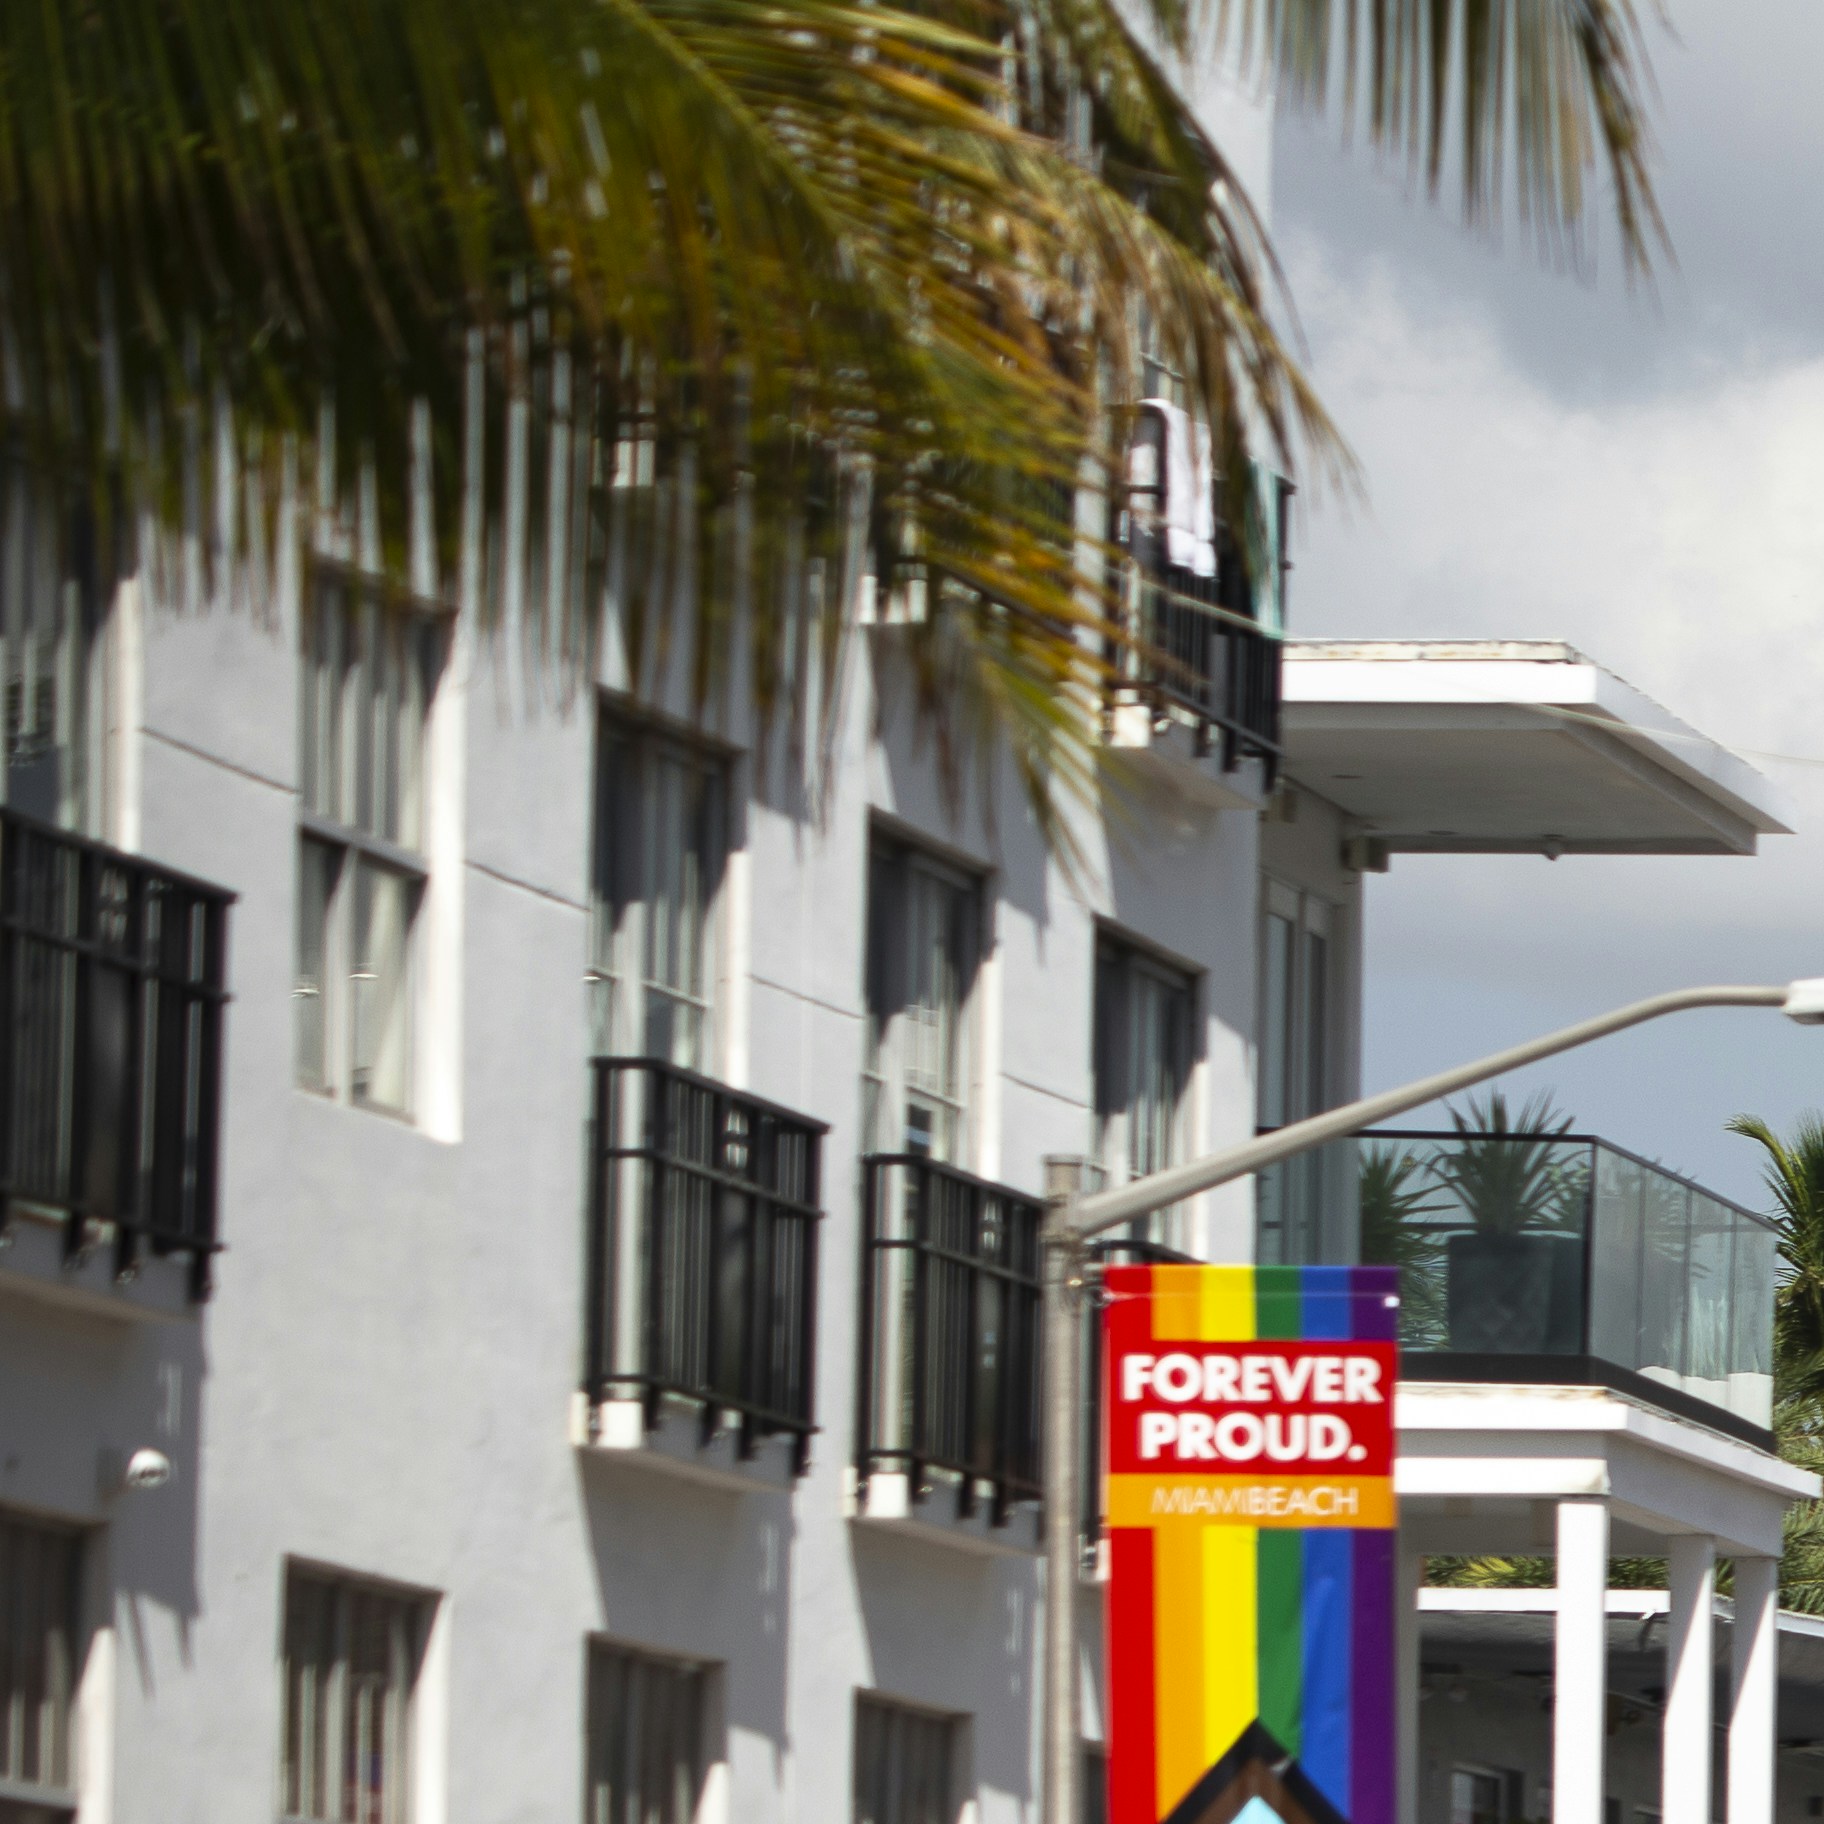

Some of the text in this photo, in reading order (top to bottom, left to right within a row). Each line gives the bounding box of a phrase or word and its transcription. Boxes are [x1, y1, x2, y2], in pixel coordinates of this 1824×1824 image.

[1121, 1353, 1384, 1403] FOREVER
[1139, 1411, 1368, 1461] PROUD.
[1151, 1486, 1359, 1515] MIAMIBEACH
